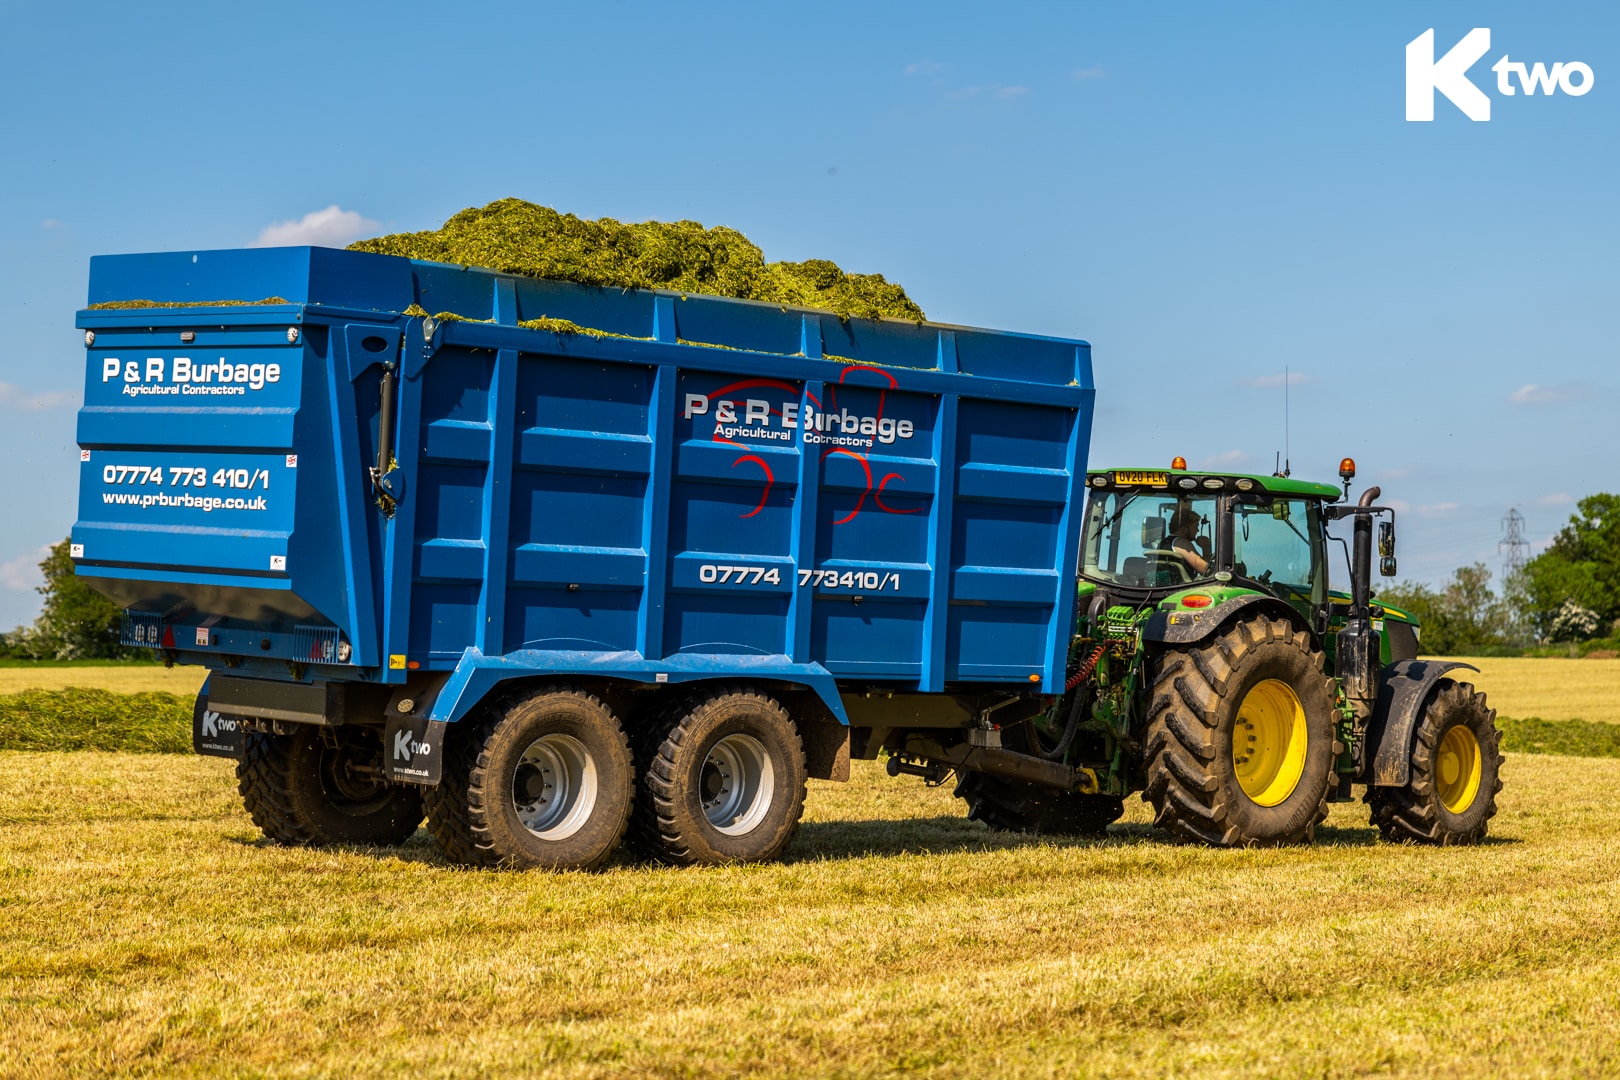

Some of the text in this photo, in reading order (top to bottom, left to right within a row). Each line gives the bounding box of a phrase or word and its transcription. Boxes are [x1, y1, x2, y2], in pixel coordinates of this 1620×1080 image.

[103, 357, 280, 390] P & R Burbage
[123, 384, 244, 397] Agricultural Contractors
[684, 393, 914, 444] P & R Burbage
[714, 423, 791, 441] Agricultural
[103, 465, 269, 490] 07774 773 410/1
[1119, 472, 1164, 482] OV20 FLK
[102, 492, 267, 512] www.prburbage.co.uk
[699, 565, 900, 591] 07774 773410/1
